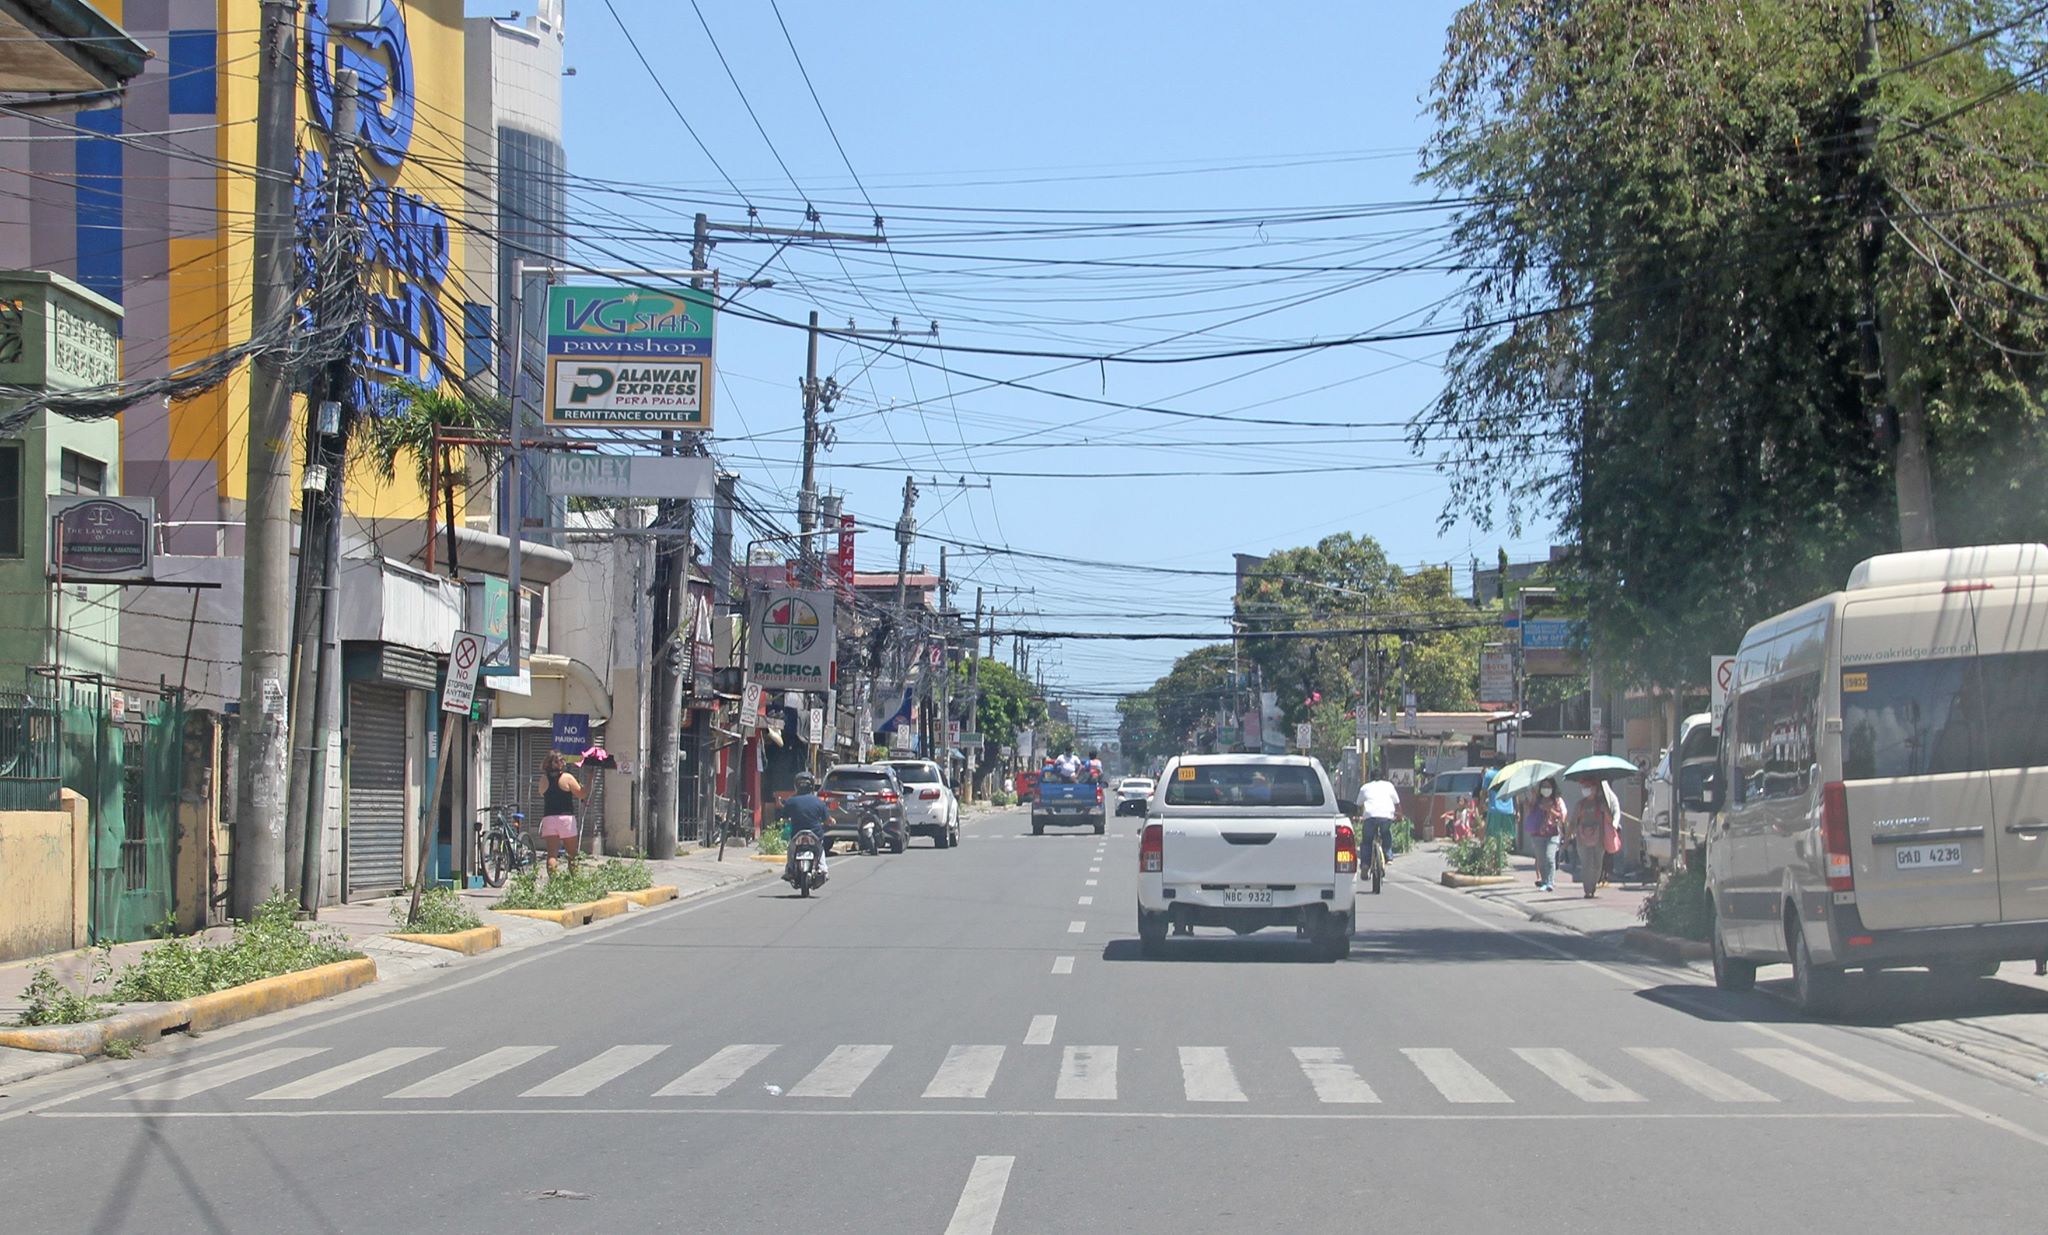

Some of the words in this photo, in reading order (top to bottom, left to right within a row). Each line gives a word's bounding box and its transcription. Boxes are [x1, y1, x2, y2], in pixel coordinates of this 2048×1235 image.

[565, 297, 628, 335] VG
[633, 311, 700, 333] STAR
[563, 338, 696, 355] pawnshop
[616, 383, 696, 396] EXPRESS
[615, 396, 648, 405] PERA
[652, 396, 696, 405] PADALA
[564, 410, 641, 421] REMITTANCE
[644, 411, 691, 421] OUTLET
[551, 457, 629, 477] MONEY
[1842, 641, 1976, 662] www.oakridge.com.ph
[456, 669, 468, 680] NO
[753, 662, 822, 677] PACIFICA
[447, 679, 473, 691] STOPPING
[445, 688, 471, 700] ANYTIME
[563, 726, 578, 735] NO
[554, 735, 586, 744] PARKING
[1225, 891, 1243, 903] NBC
[1248, 891, 1271, 903] 9322
